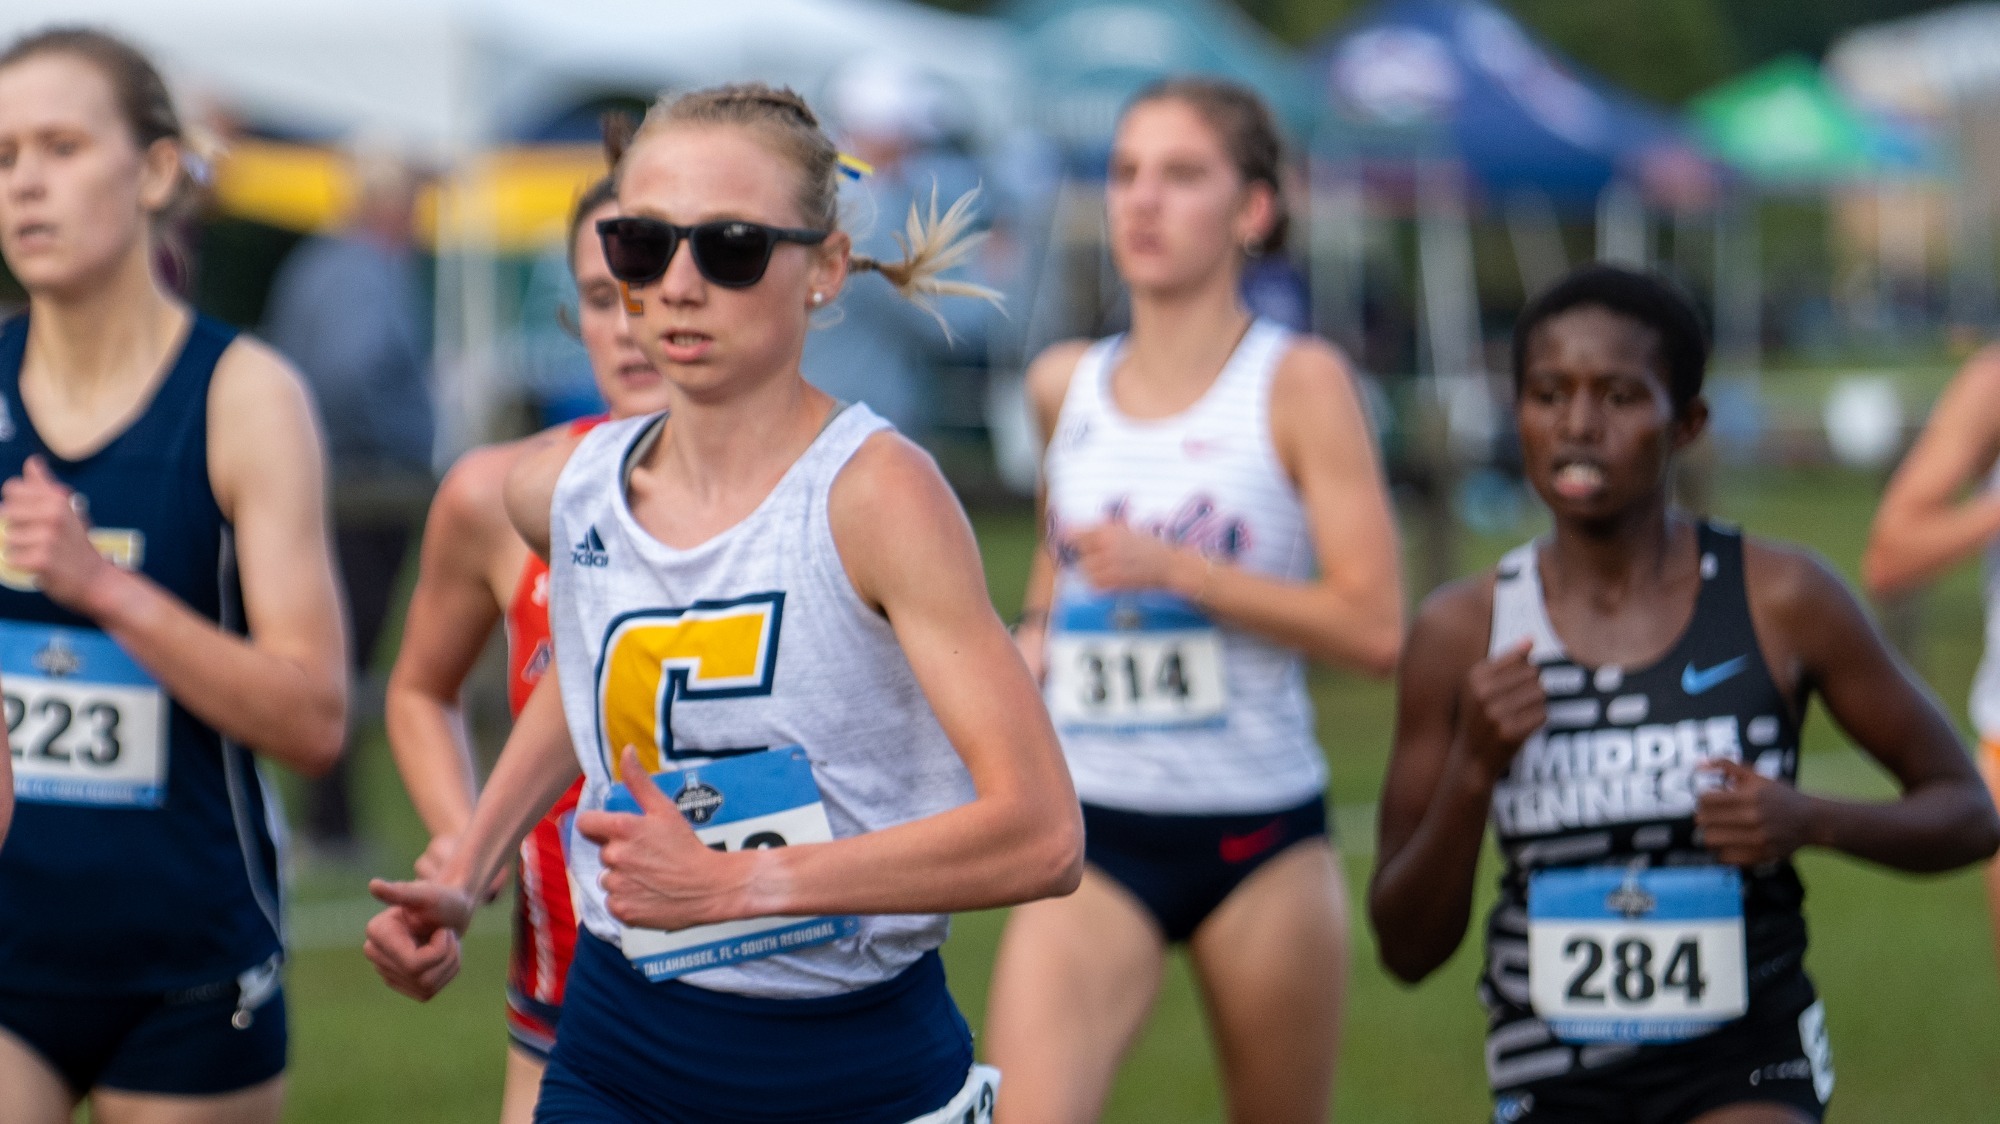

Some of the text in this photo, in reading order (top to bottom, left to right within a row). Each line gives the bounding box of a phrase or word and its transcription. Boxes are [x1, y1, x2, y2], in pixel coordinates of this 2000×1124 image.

[1074, 643, 1191, 708] 314
[1510, 715, 1742, 786] MIDDLE
[1493, 764, 1738, 836] TENNES
[643, 922, 836, 978] TALLAHASSEE, FL SOUTH REGIONAL
[1562, 933, 1707, 1005] 284
